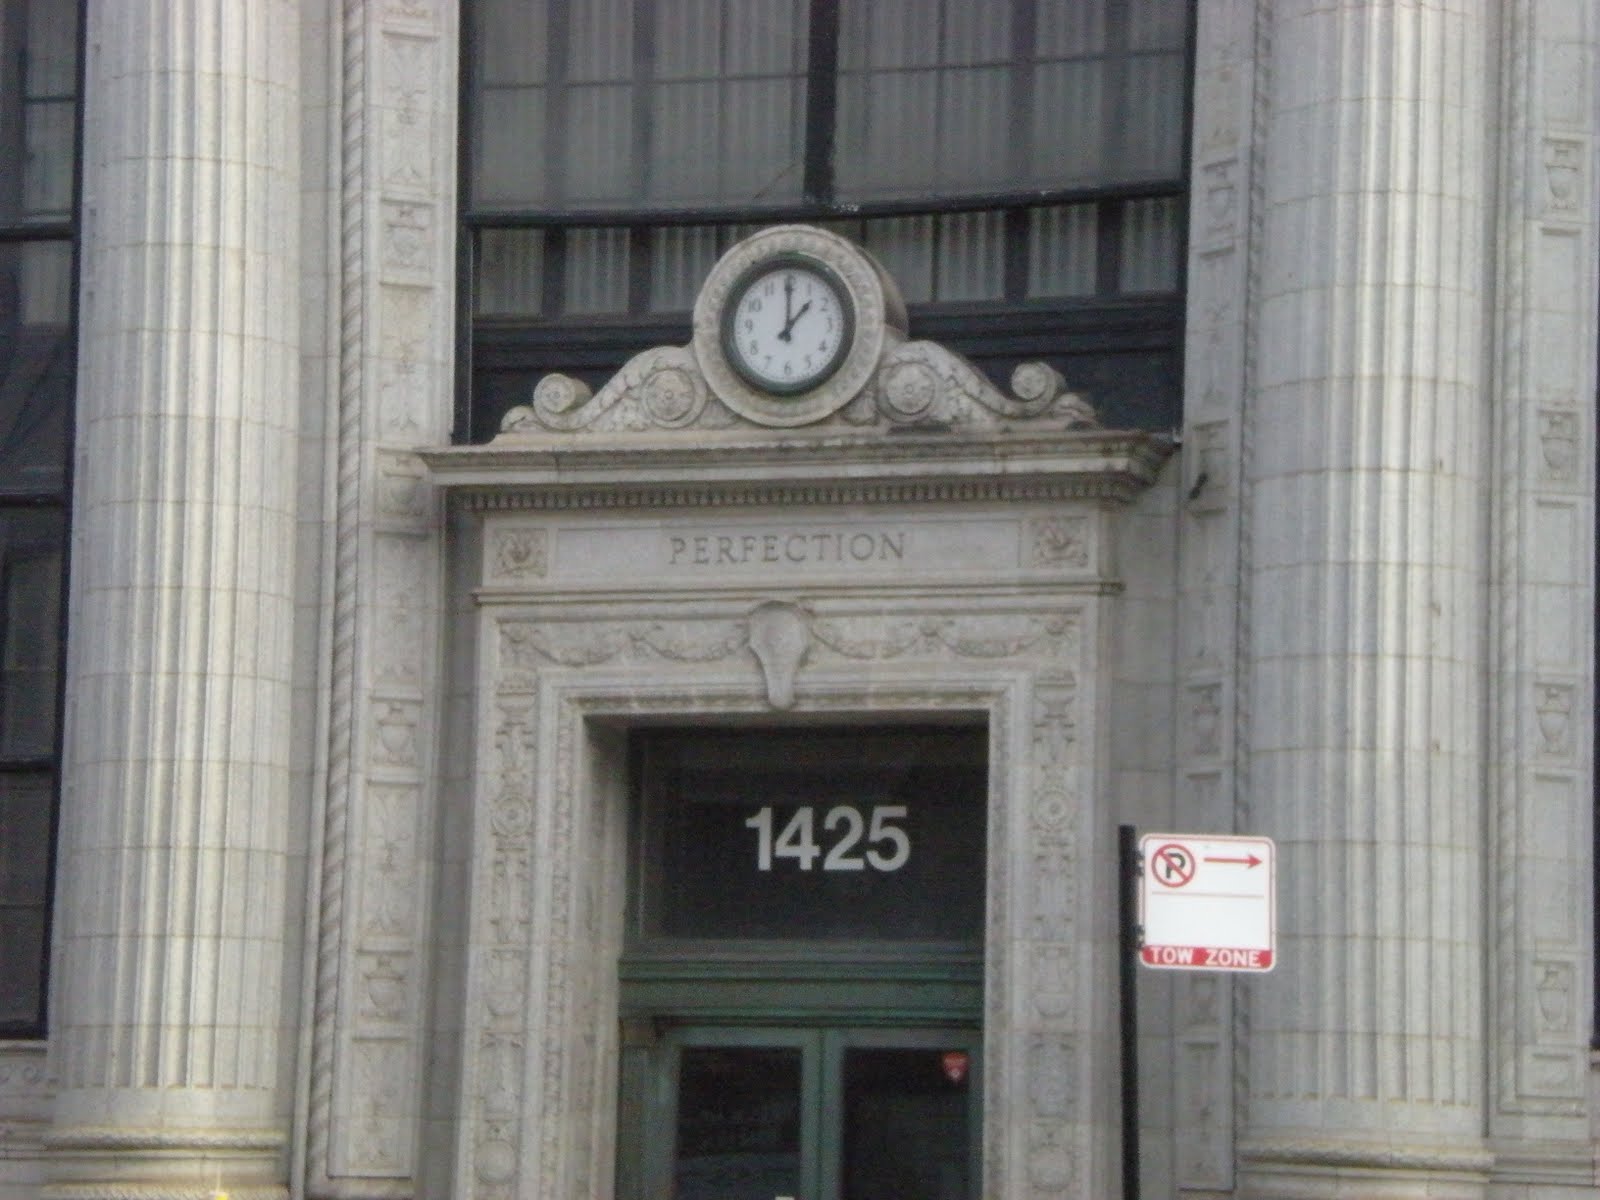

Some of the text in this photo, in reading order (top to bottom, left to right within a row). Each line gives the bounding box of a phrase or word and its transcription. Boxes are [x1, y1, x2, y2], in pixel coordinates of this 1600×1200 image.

[747, 298, 763, 313] 10
[819, 297, 829, 312] 2
[744, 318, 753, 335] 9
[750, 338, 760, 356] 8
[817, 338, 828, 352] 4
[763, 354, 773, 371] 7
[783, 359, 793, 376] 6
[668, 532, 906, 566] PERFECTION
[745, 805, 910, 872] 1425
[1150, 946, 1262, 968] TOW ZONE
